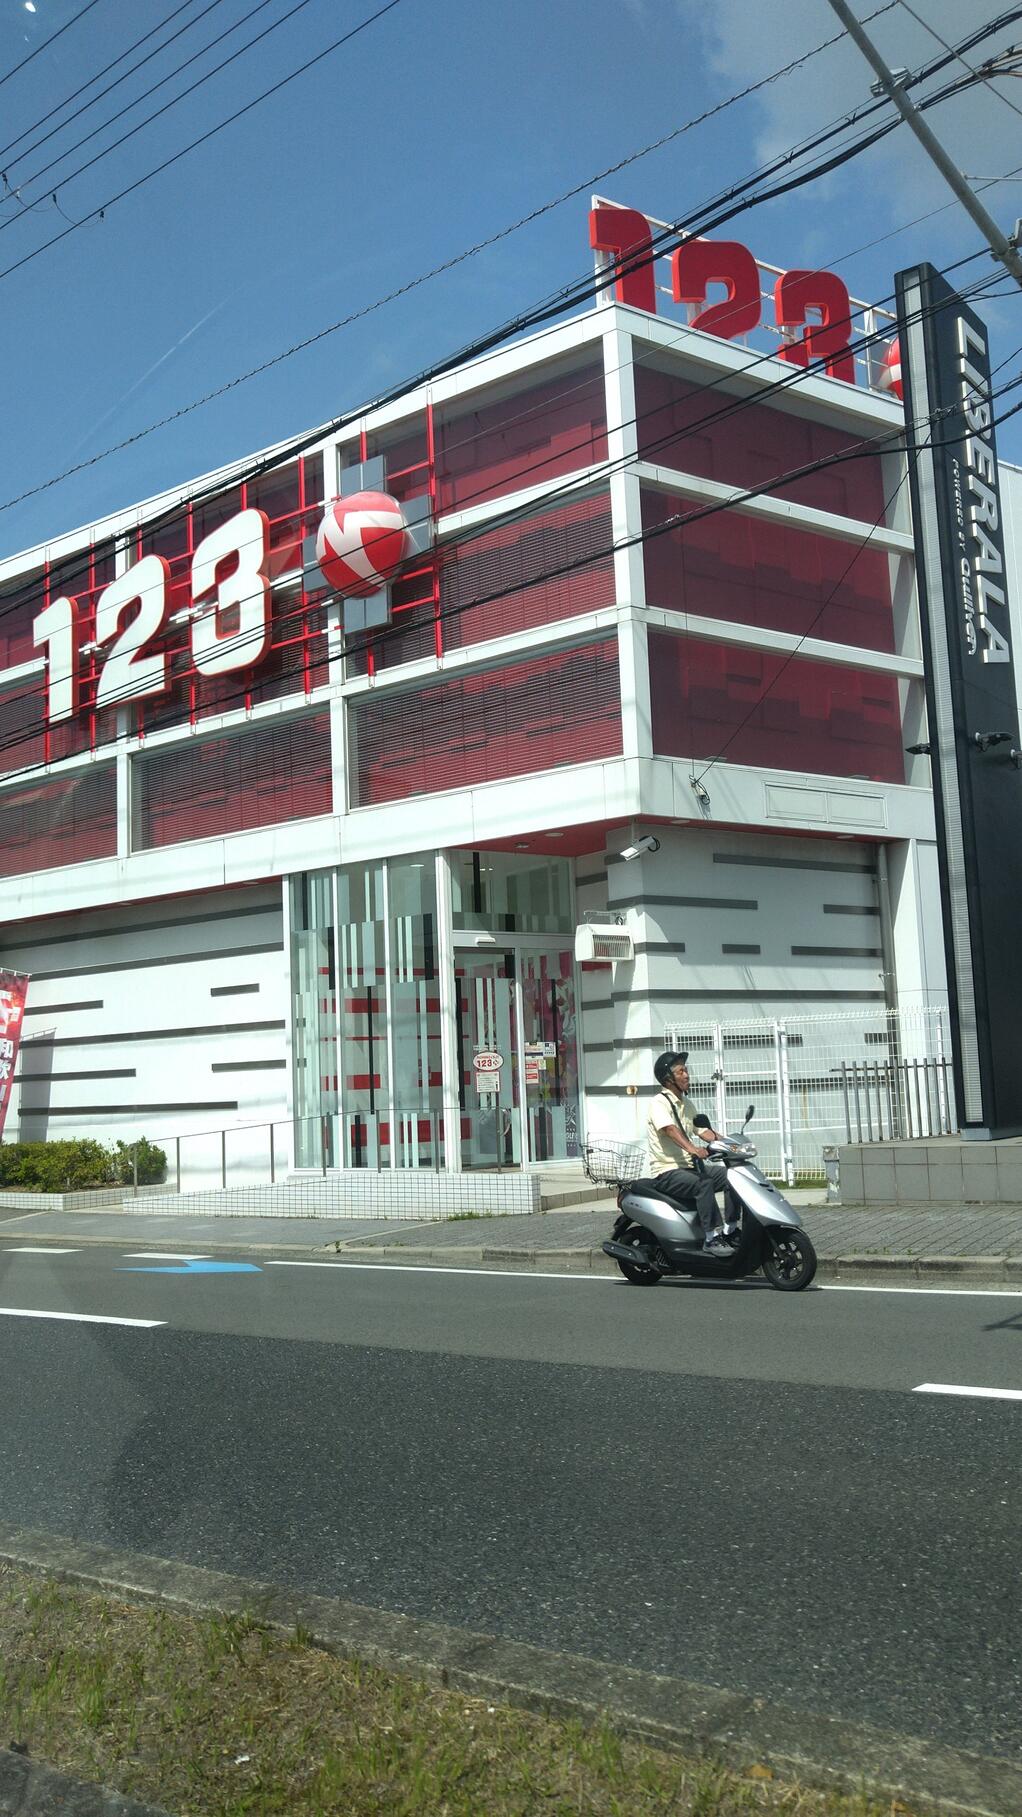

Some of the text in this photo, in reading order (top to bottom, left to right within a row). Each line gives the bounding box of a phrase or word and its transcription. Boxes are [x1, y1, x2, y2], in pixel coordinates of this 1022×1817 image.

[952, 457, 978, 656] POWERED BY Gulliver
[958, 317, 1010, 664] LIBERALA
[32, 508, 271, 723] 123
[477, 1059, 492, 1067] 123
